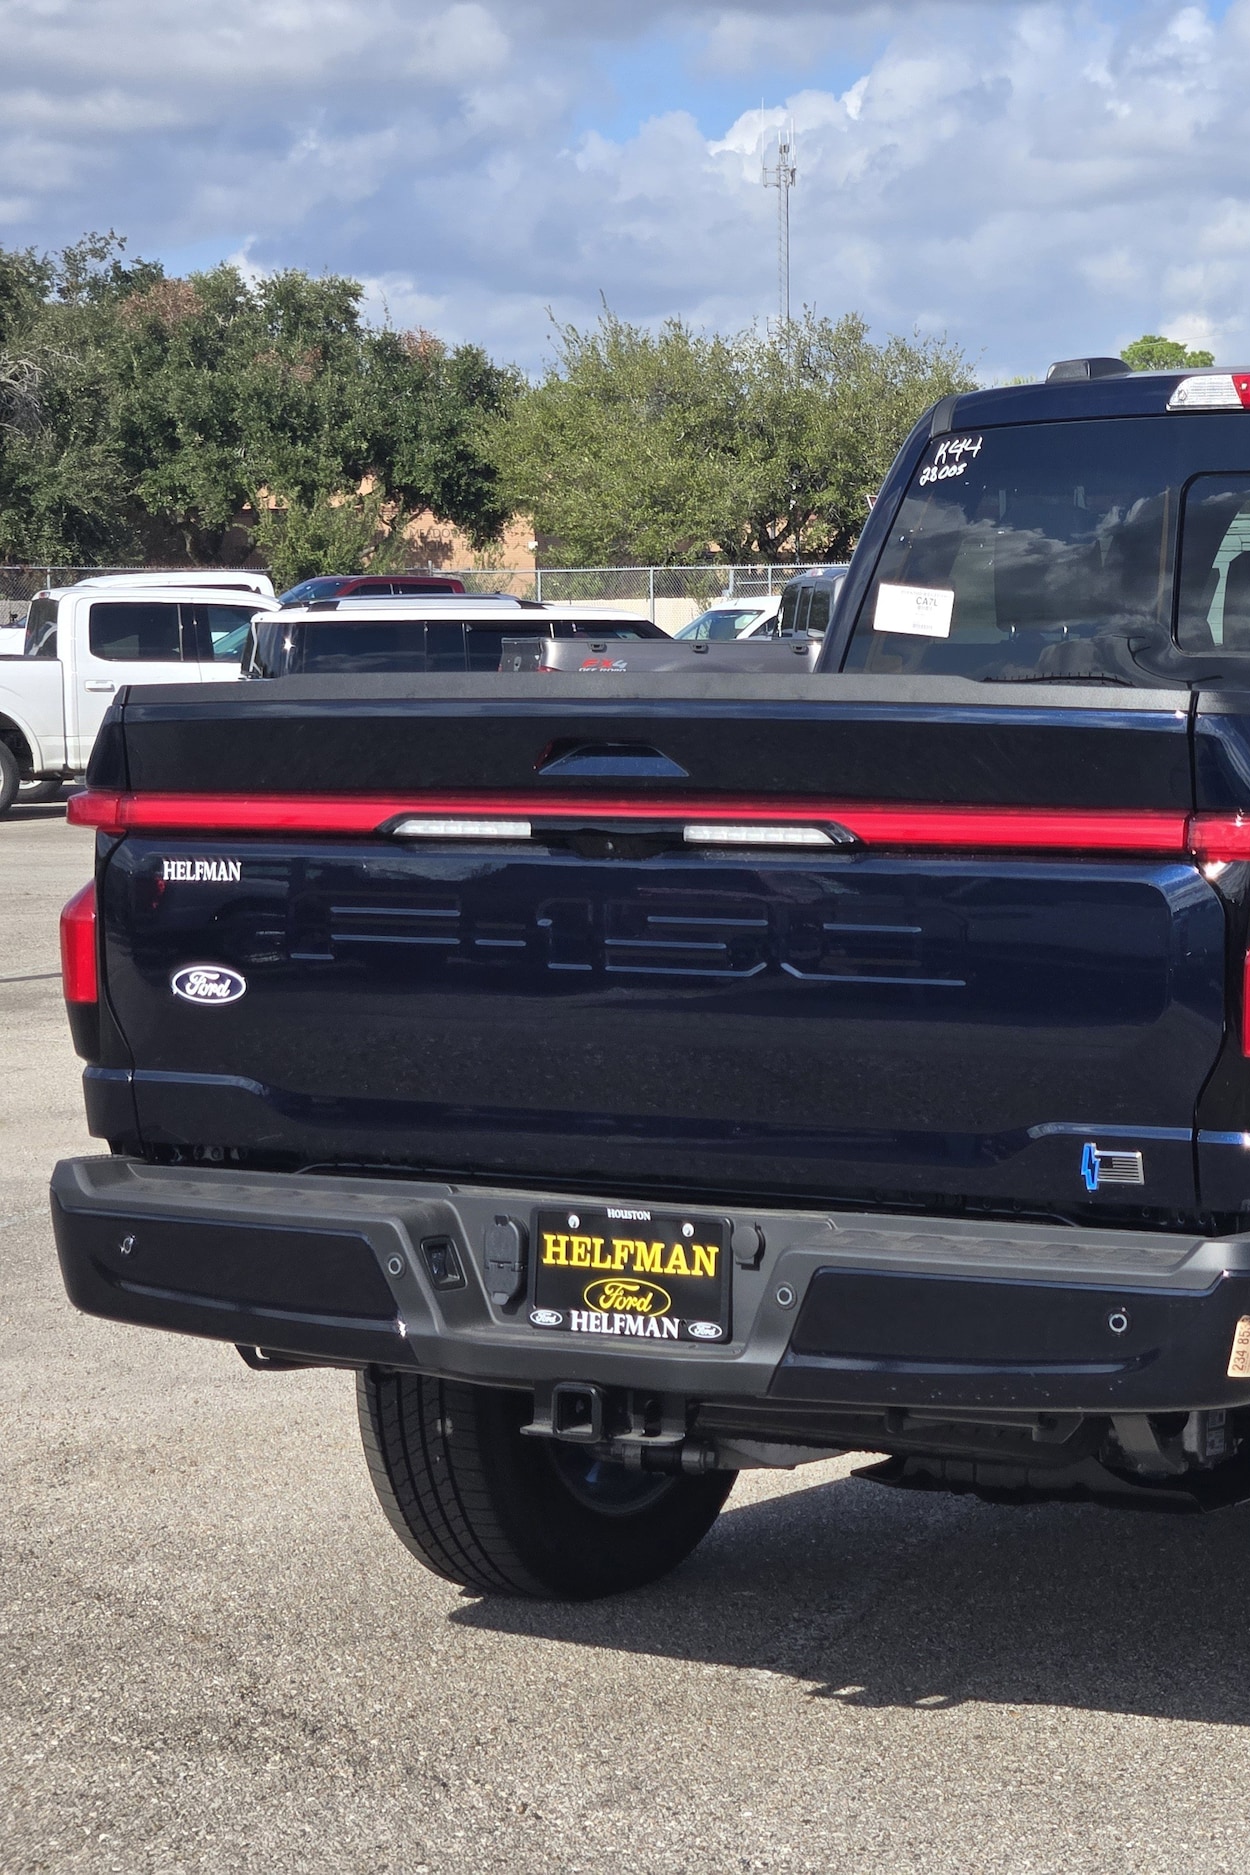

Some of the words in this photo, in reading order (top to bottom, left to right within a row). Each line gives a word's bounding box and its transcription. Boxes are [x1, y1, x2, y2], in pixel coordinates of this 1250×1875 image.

[581, 658, 629, 668] FX4
[163, 860, 242, 882] HELFMAN
[184, 970, 232, 998] Ford
[607, 1208, 651, 1221] HOUSTON
[542, 1233, 719, 1277] HELFMAN
[598, 1281, 654, 1313] Ford
[570, 1310, 680, 1339] HELFMAN
[1232, 1350, 1248, 1371] 234
